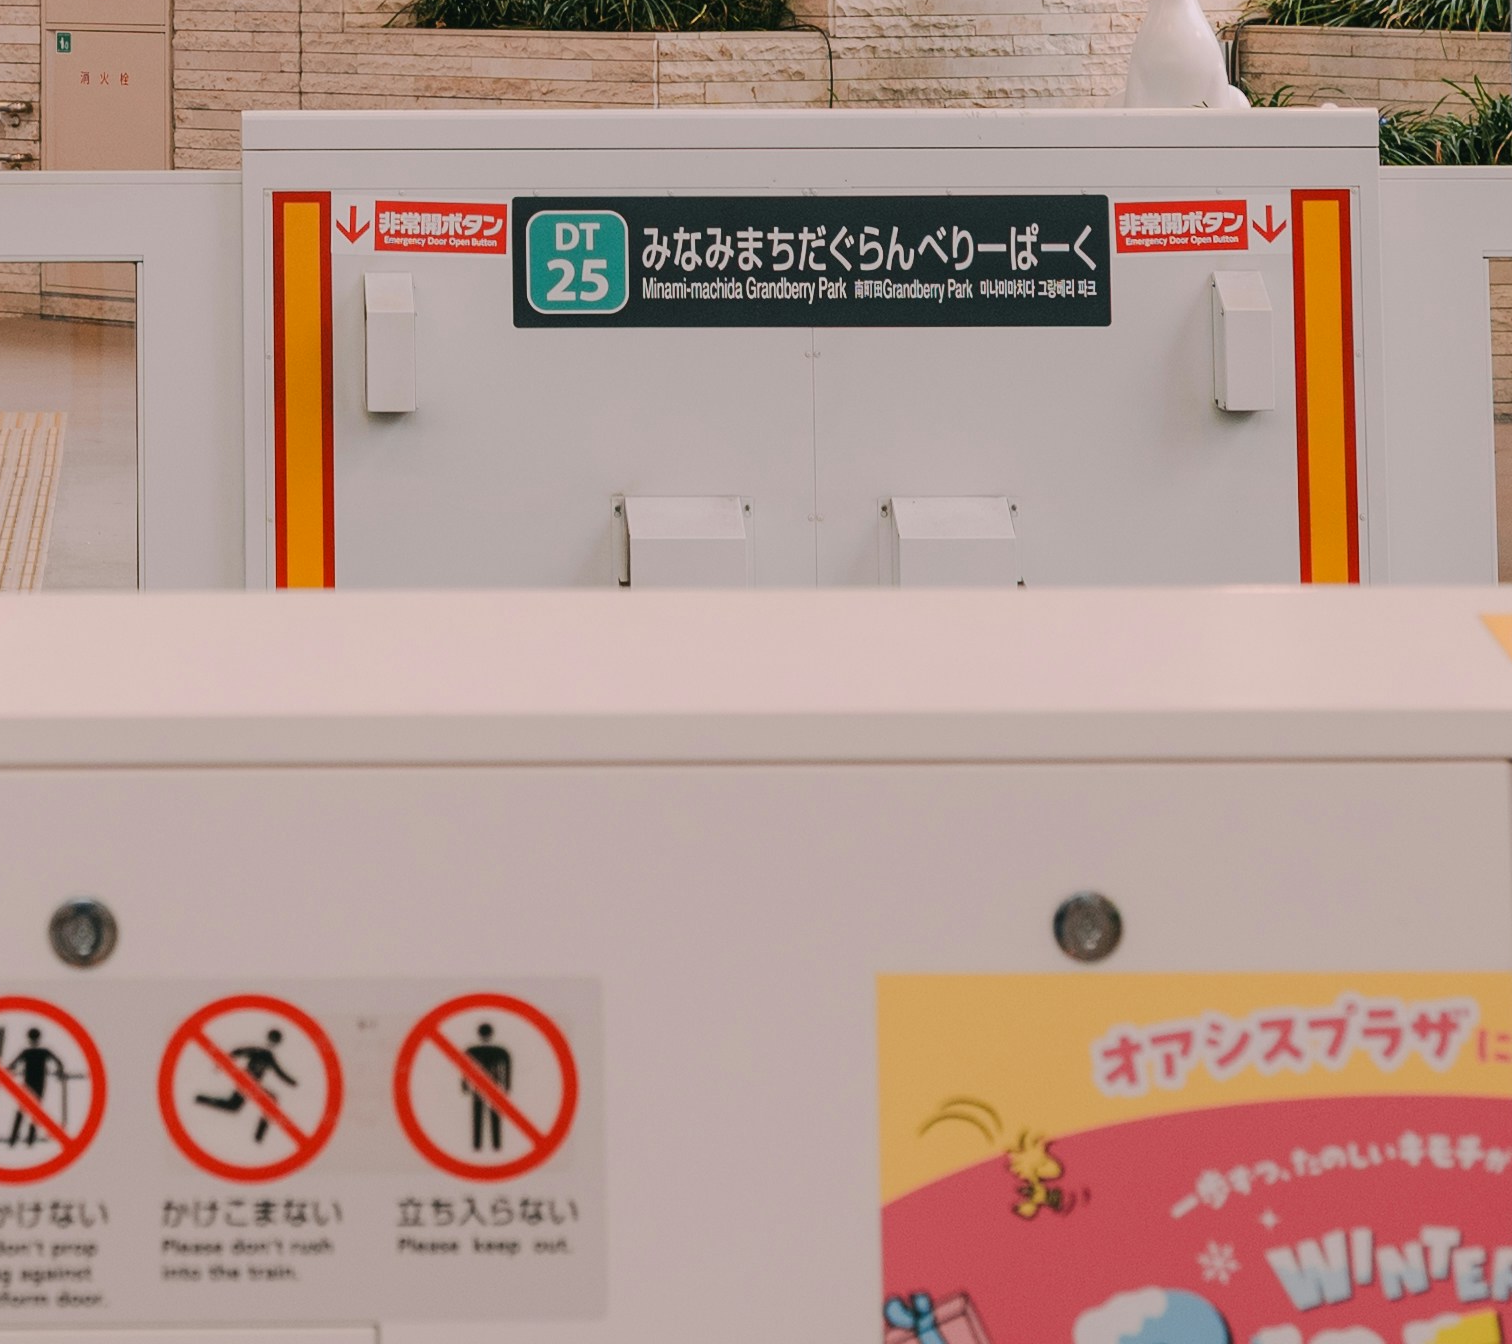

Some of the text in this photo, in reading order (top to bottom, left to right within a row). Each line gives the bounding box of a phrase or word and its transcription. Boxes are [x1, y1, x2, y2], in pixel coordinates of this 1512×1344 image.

[378, 212, 503, 236] 非常開ボタン
[1119, 211, 1244, 236] 非常開ボタン
[384, 236, 497, 248] Emergency Door Open Button
[555, 222, 600, 251] DT
[642, 223, 1097, 271] みなみまちだぐらんべりーぱーく
[1126, 235, 1239, 247] Emergency Door Open Button
[546, 258, 609, 302] 25
[642, 276, 847, 305] Minami-machida Grandberry Park
[948, 278, 973, 299] Park
[162, 1199, 344, 1228] かけこまない
[397, 1196, 580, 1228] 立ち入らない
[51, 1242, 98, 1259] prop
[162, 1238, 222, 1255] Please
[291, 1239, 334, 1255] rush
[397, 1238, 459, 1254] Please
[474, 1238, 521, 1257] keep
[20, 1266, 92, 1285] against
[163, 1265, 202, 1281] into
[209, 1265, 240, 1281] the
